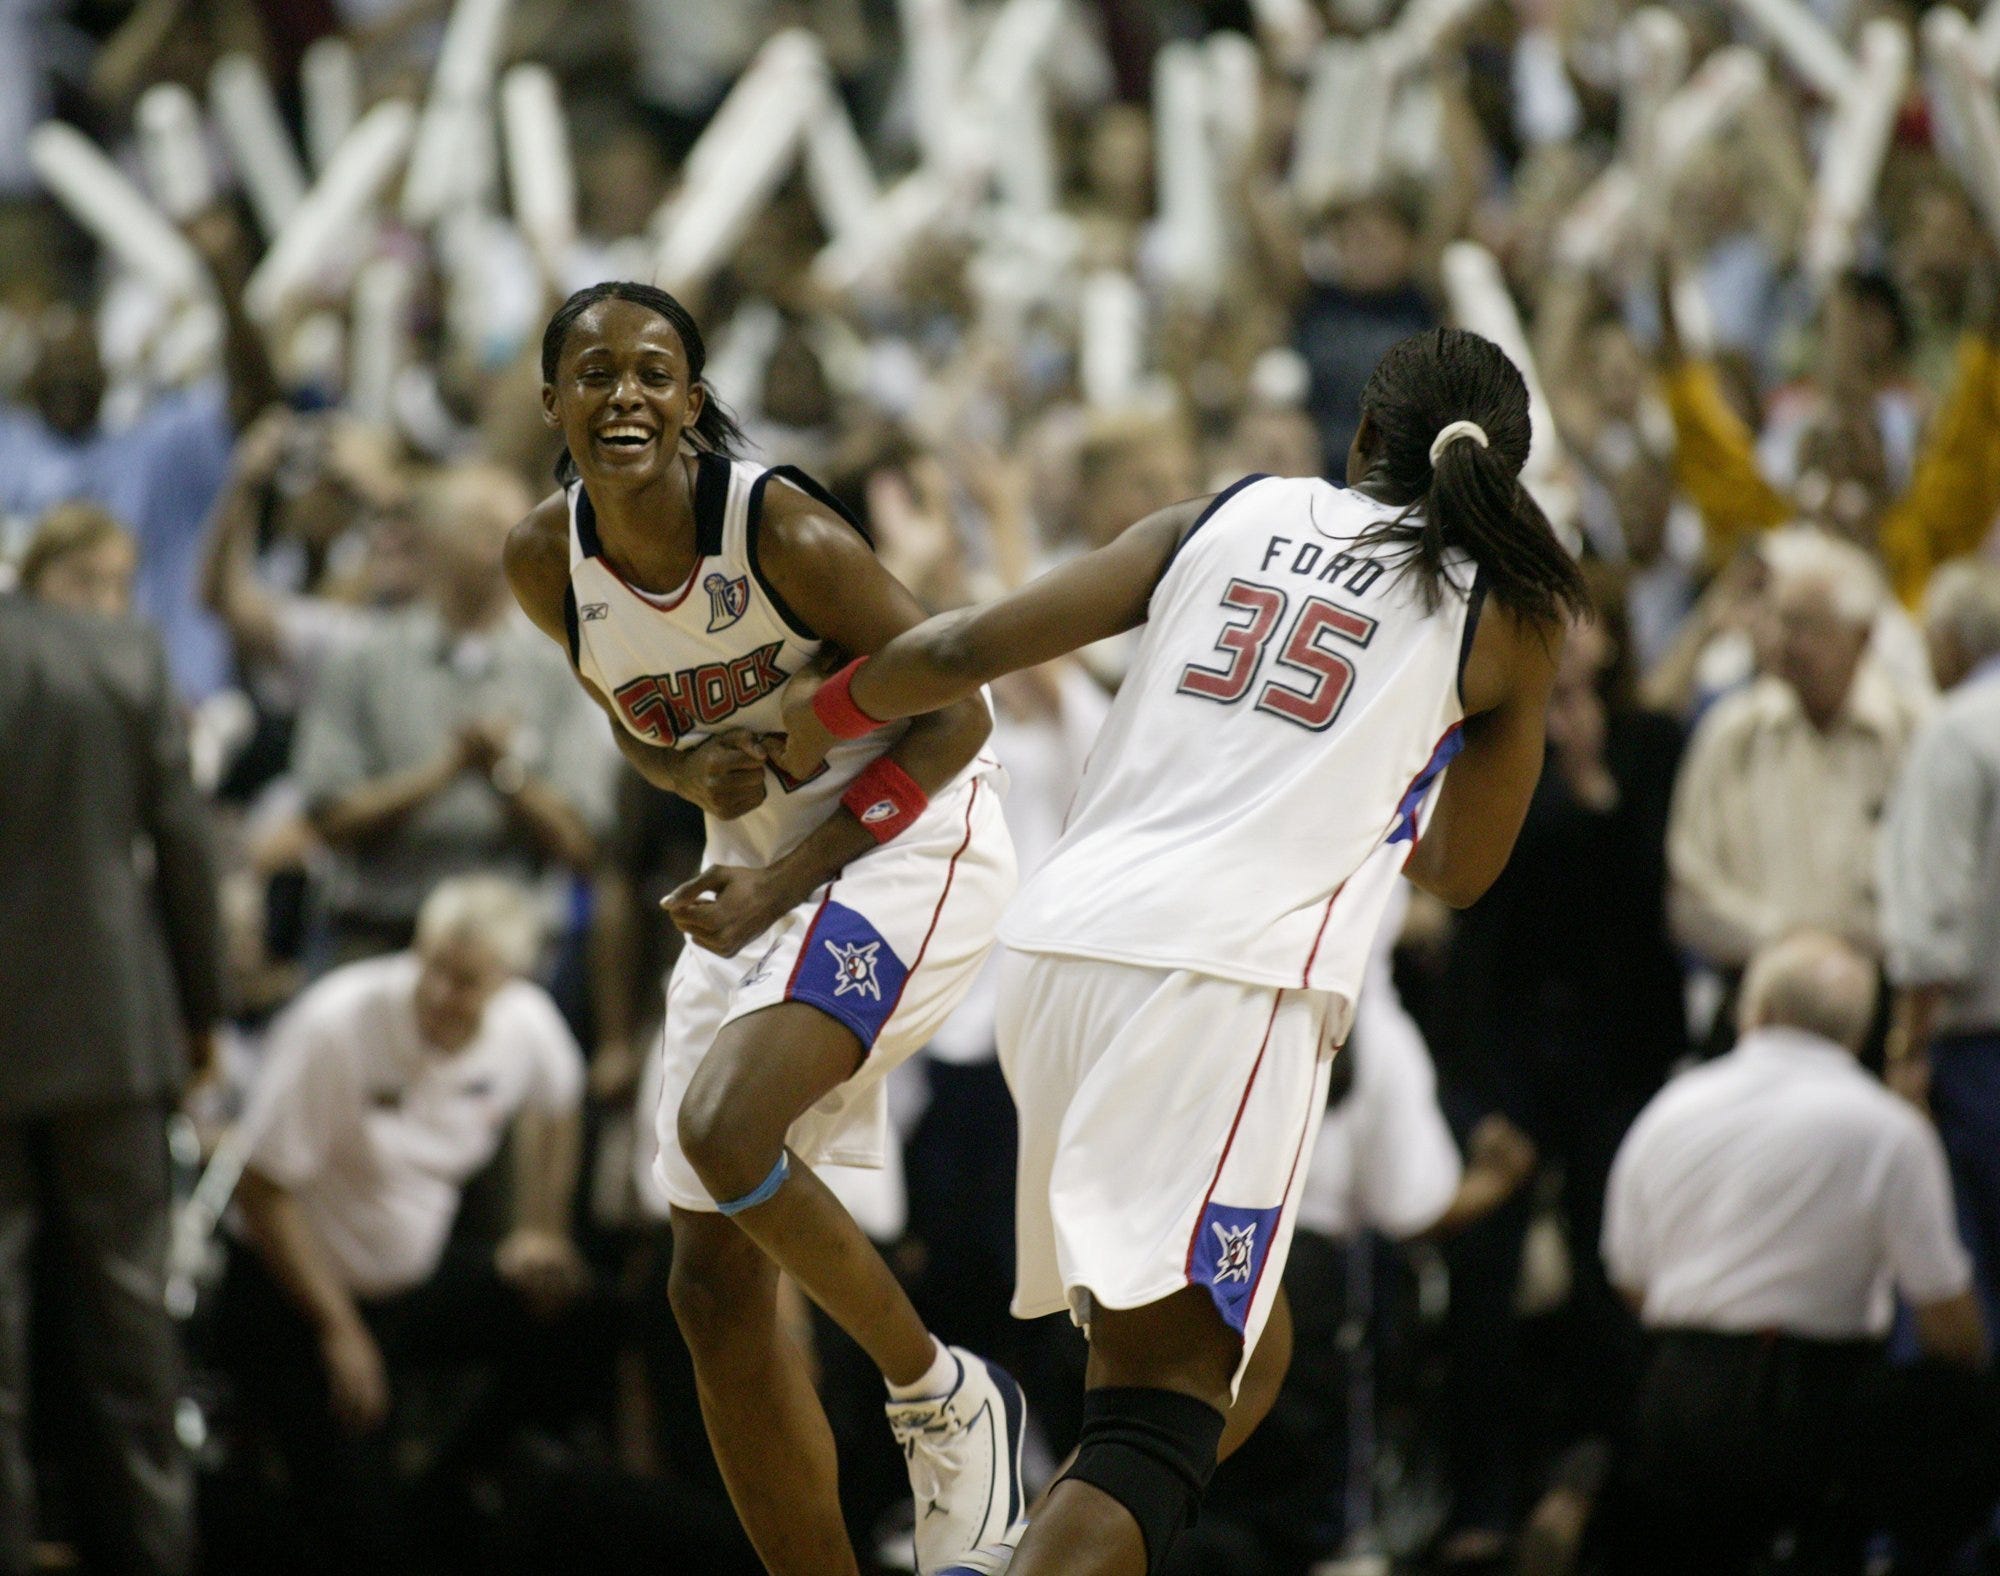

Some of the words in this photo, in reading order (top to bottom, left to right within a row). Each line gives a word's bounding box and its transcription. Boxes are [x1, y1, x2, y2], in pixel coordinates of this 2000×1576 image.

[1260, 535, 1384, 597] FORD
[613, 640, 791, 748] SHOCK
[1176, 577, 1379, 732] 35
